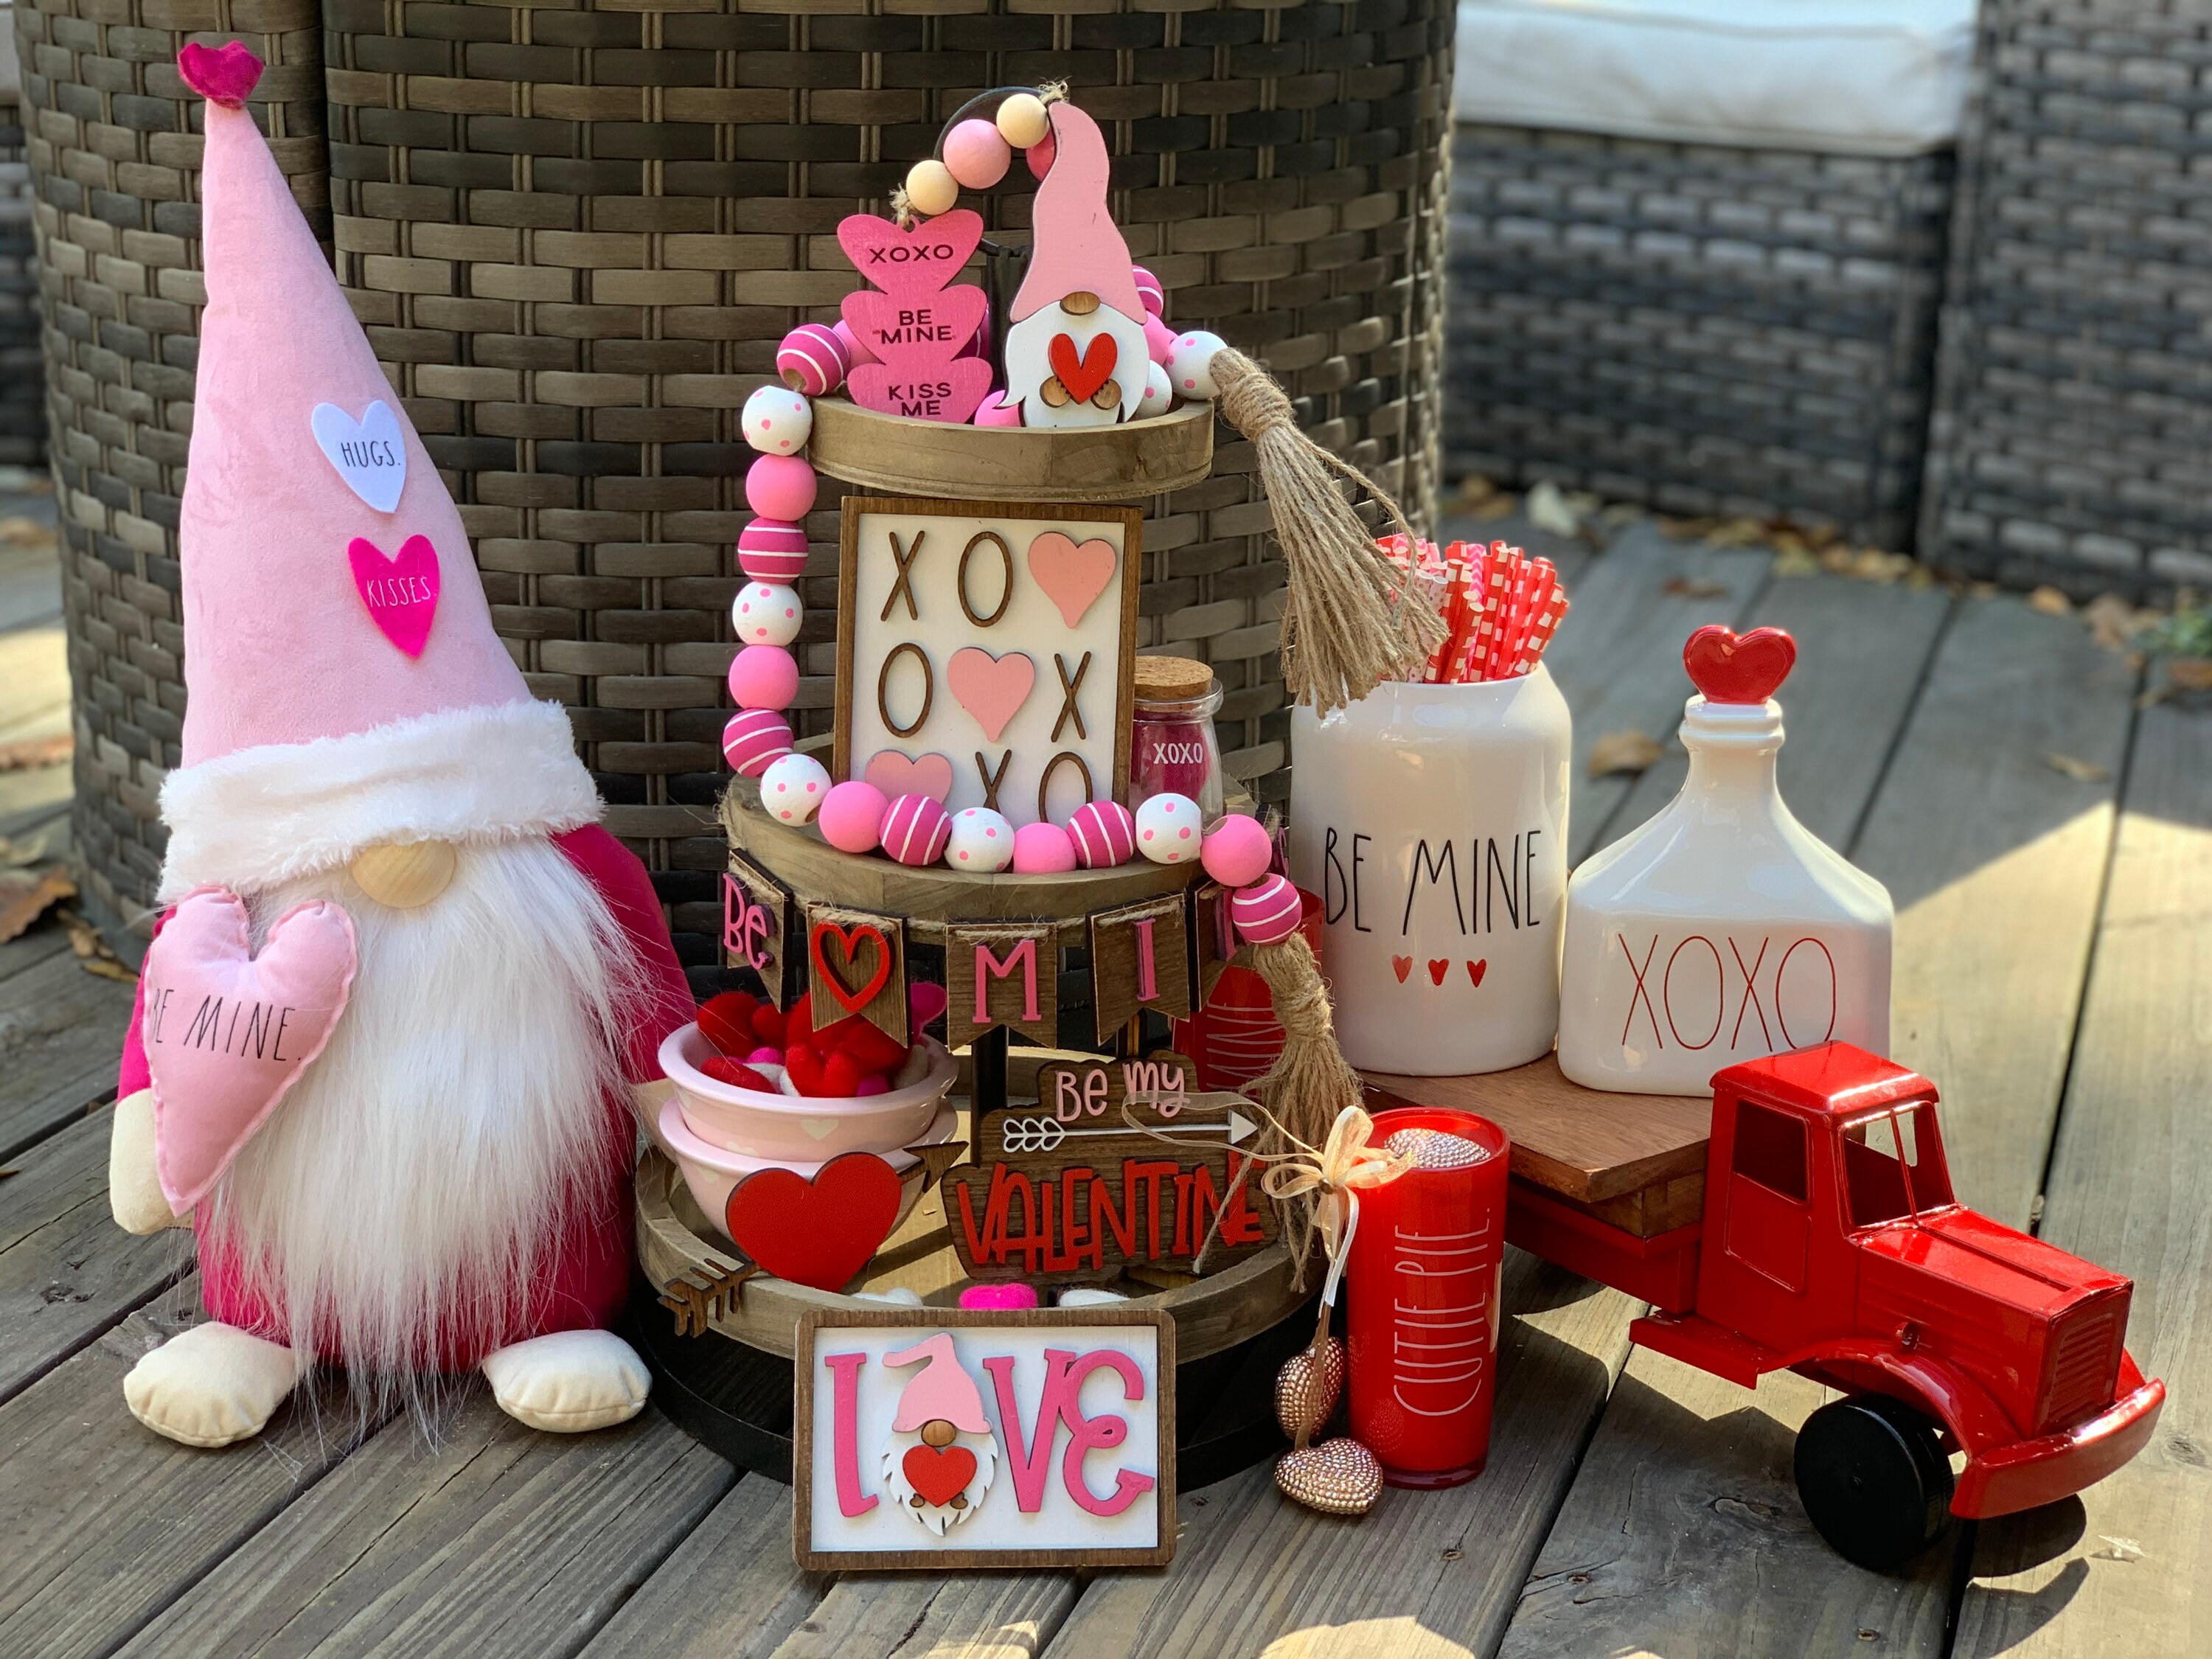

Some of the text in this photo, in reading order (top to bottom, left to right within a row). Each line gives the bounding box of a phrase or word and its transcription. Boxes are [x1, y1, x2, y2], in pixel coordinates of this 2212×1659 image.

[869, 244, 954, 264] XOXO
[881, 325, 952, 344] MINE
[899, 309, 932, 326] BE
[888, 382, 952, 400] KISS
[901, 400, 941, 417] ME
[1153, 742, 1203, 764] XOXO
[1325, 827, 1371, 933] BE
[1403, 830, 1542, 936] MINE
[723, 872, 774, 970] Be
[1617, 933, 1836, 1052] XOXO
[1055, 1068, 1108, 1122] Be
[958, 1150, 1267, 1273] VALENTINE
[1393, 1292, 1486, 1416] CUTIE
